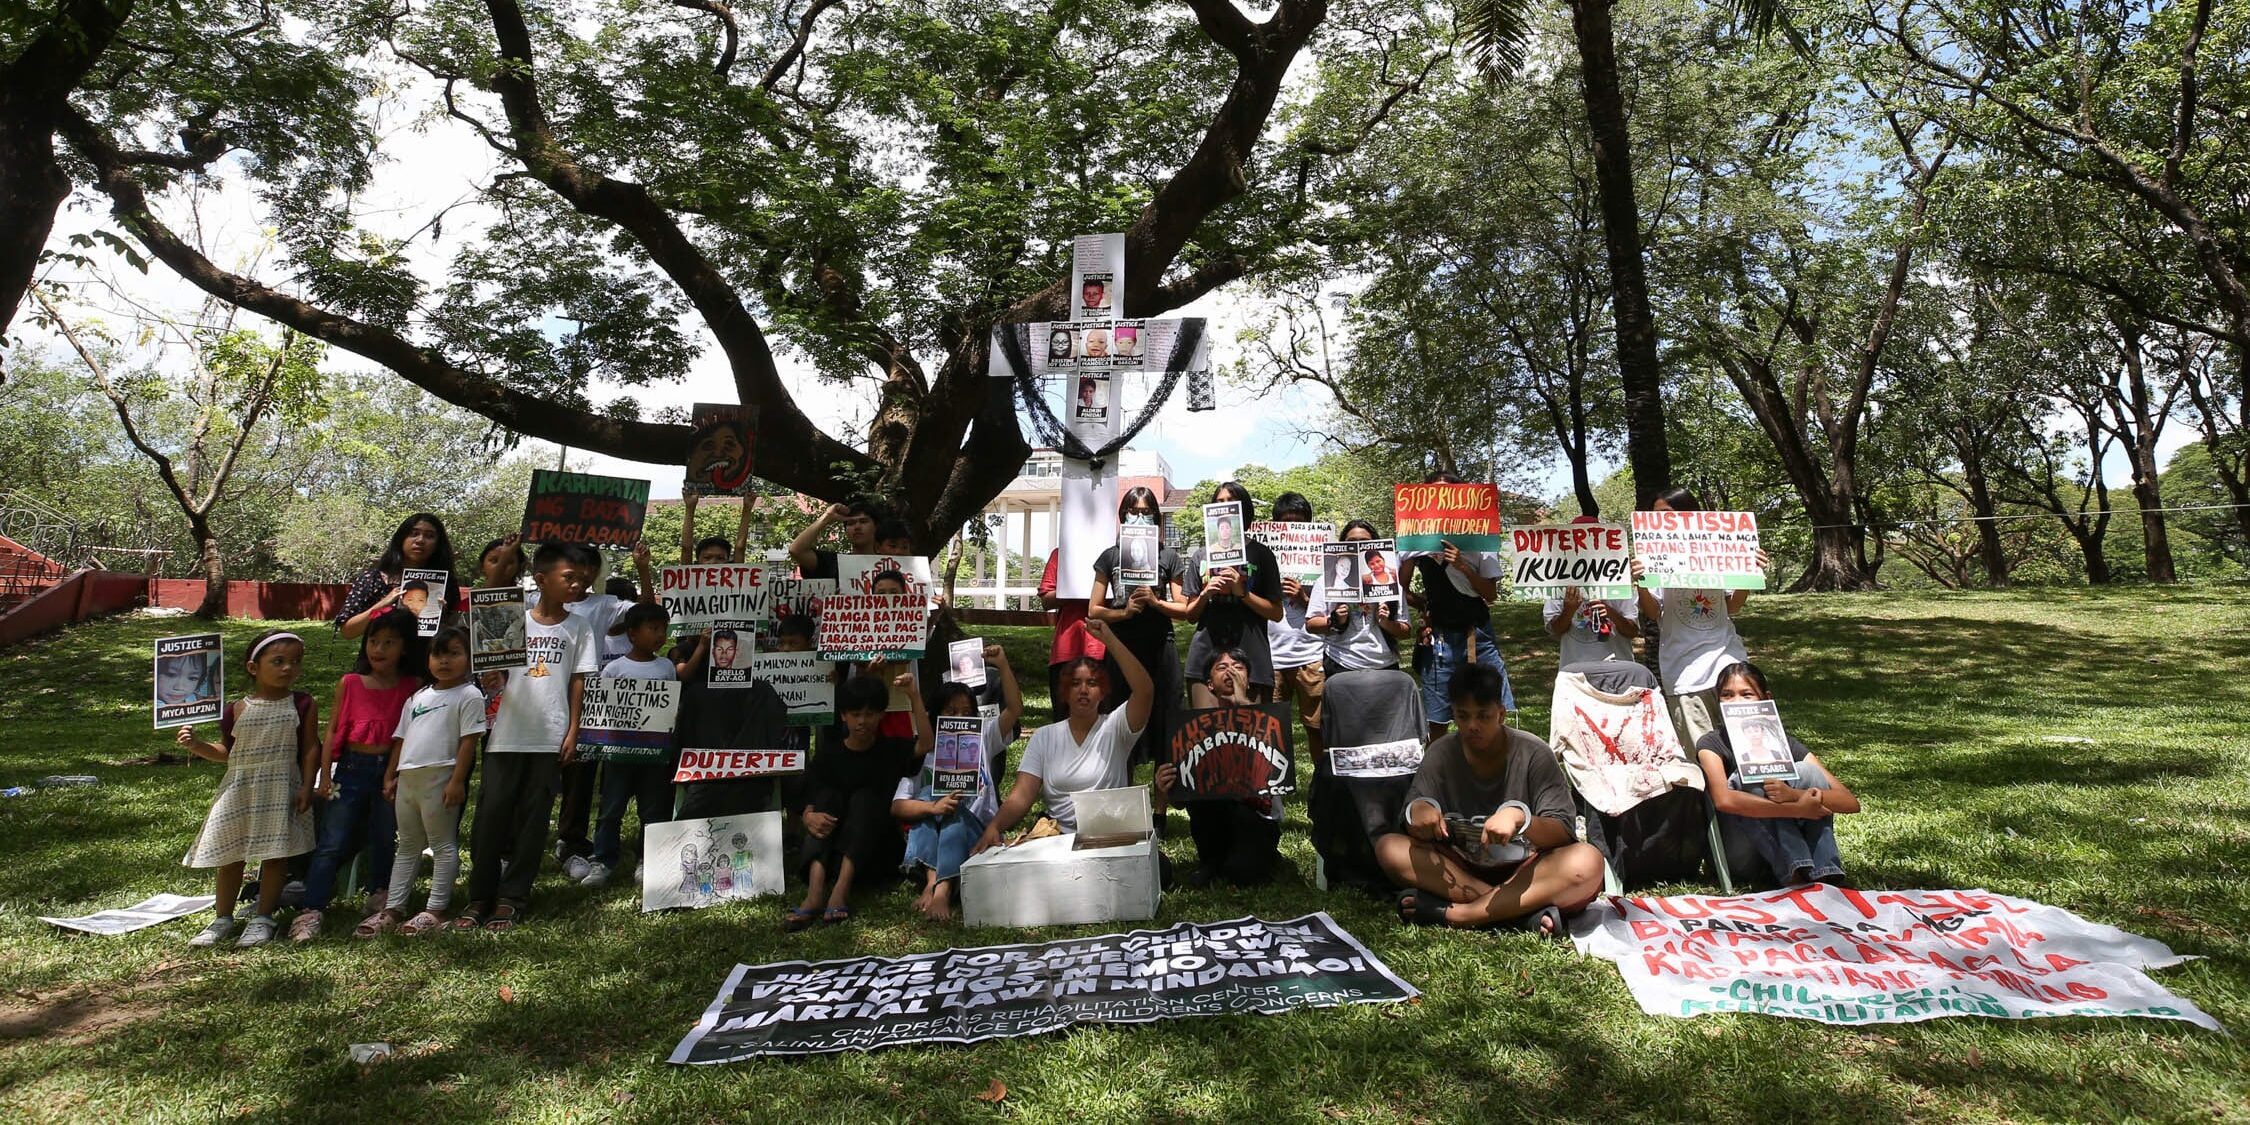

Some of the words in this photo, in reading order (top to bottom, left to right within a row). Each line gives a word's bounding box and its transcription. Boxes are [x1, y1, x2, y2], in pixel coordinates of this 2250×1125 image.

[1397, 486, 1437, 512] STOP
[1437, 486, 1492, 511] KILLING
[1208, 507, 1229, 516] JUSTICE
[1397, 518, 1443, 537] INNOCENT
[1443, 518, 1490, 536] CHILDREN
[1632, 512, 1754, 532] HUSTISYA
[1280, 532, 1329, 544] PINASLANG
[1514, 527, 1623, 553] DUTERTE
[1634, 532, 1663, 541] PARA
[1667, 532, 1679, 540] SA
[1682, 532, 1713, 540] LAHAT
[1718, 533, 1732, 541] NA
[1736, 534, 1758, 542] MGA
[1360, 542, 1384, 550] JUSTICE
[1635, 542, 1686, 555] BATANG
[1690, 542, 1748, 554] BIKTIMA
[404, 572, 437, 580] JUSTICE
[1516, 557, 1628, 583] IKULONG!
[663, 567, 763, 591] DUTERTE
[474, 592, 508, 602] JUSTICE
[1524, 586, 1608, 600] SALINAHI
[662, 592, 767, 618] PANAGUTIN!
[824, 596, 889, 610] HUSTISYA
[892, 594, 927, 608] PARA
[822, 612, 837, 622] SA
[840, 611, 870, 622] MGA
[874, 610, 923, 622] BATANG
[820, 623, 870, 634] BIKTIMA
[874, 624, 890, 633] NG
[160, 640, 202, 652] JUSTICE
[820, 634, 858, 644] LABAG
[860, 635, 874, 644] SA
[824, 652, 864, 660] Children's
[764, 659, 798, 669] MILYON
[801, 659, 814, 668] NA
[614, 678, 637, 690] FOR
[645, 680, 668, 692] ALL
[617, 692, 670, 708] VICTIMS
[162, 706, 184, 718] MYCA
[186, 704, 216, 715] ULPINA
[605, 706, 642, 720] RIGHTS
[1727, 706, 1760, 716] JUSTICE
[940, 720, 968, 730] JUSTICE
[680, 752, 798, 769] DUTERTE
[1748, 766, 1758, 774] JP
[1679, 919, 1790, 933] PARA
[756, 960, 936, 984] JUSTICE
[944, 952, 1030, 970] FOR
[1038, 942, 1110, 960] ALL
[752, 972, 937, 1000] VICTIMS
[946, 964, 1006, 979] OF
[775, 988, 858, 1004] ON
[865, 972, 1035, 1006] DRUGS
[1061, 955, 1206, 982] MEMO
[715, 999, 930, 1033] MARTIAL
[942, 980, 1047, 1010] LAW
[1052, 978, 1098, 999] IN
[1110, 956, 1366, 992] MINDANAO!
[832, 1013, 982, 1038] CHILDREN'S
[991, 995, 1184, 1020] REHABILITATION
[1192, 982, 1281, 1004] CENTER
[739, 1036, 876, 1049] SALINLAHI
[880, 1022, 1010, 1041] ALLIANCE
[1016, 1014, 1068, 1032] FOR
[1230, 988, 1364, 1010] CONCERNS
